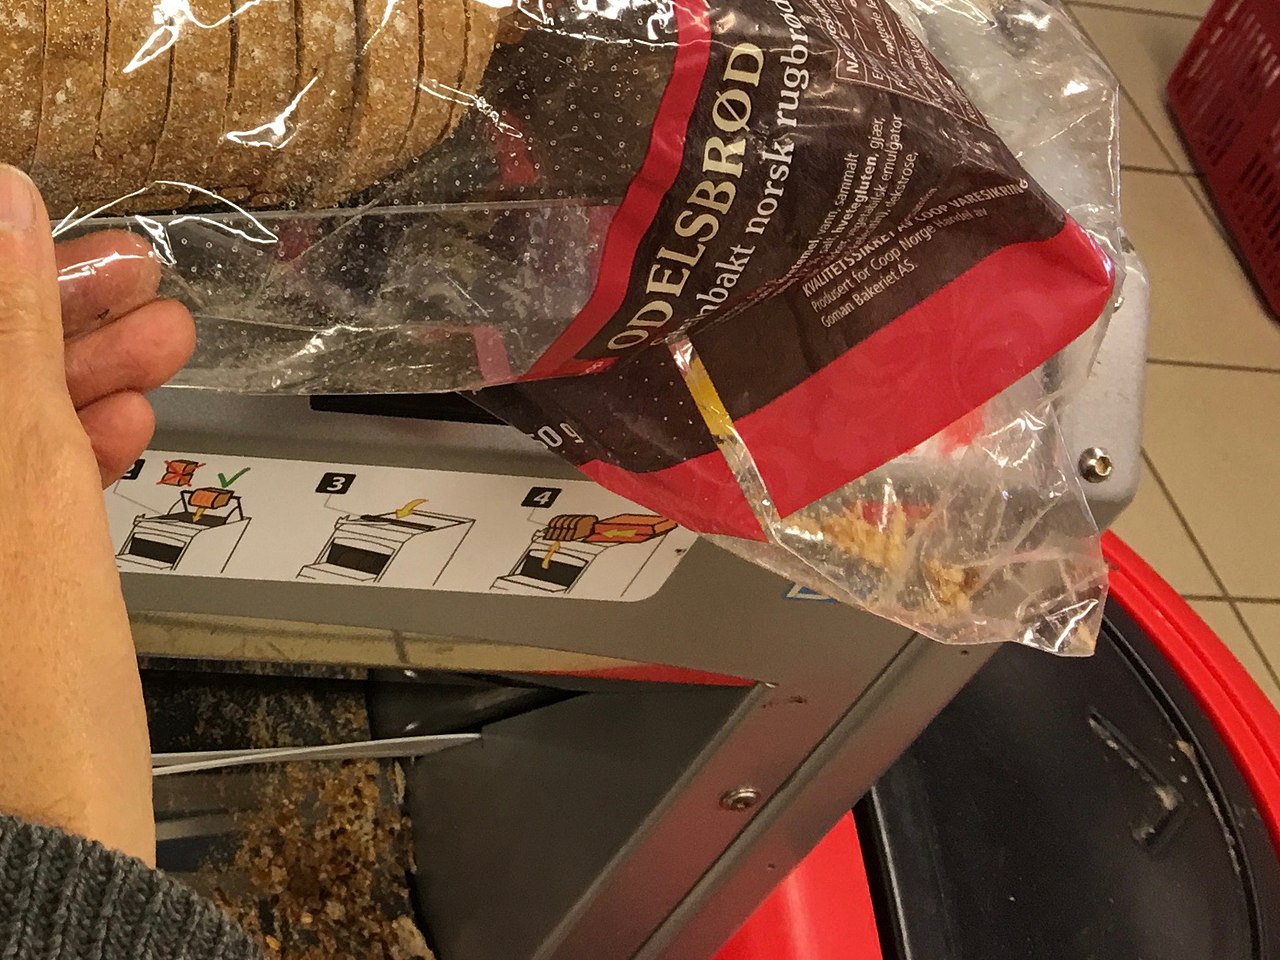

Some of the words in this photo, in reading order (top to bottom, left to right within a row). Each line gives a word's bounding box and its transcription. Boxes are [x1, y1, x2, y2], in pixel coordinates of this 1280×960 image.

[835, 152, 860, 207] sammalt
[881, 113, 904, 182] emulgator
[607, 42, 764, 351] ODELSBRØD
[745, 138, 795, 236] norsk
[831, 153, 880, 234] hvetegluten,
[811, 278, 854, 313] Produsert
[852, 266, 872, 284] for
[870, 247, 902, 272] Coop
[898, 224, 937, 253] Norge
[821, 300, 856, 329] Goman
[852, 270, 900, 307] Bakeriet
[326, 476, 347, 492] 3
[532, 490, 552, 506] 4
